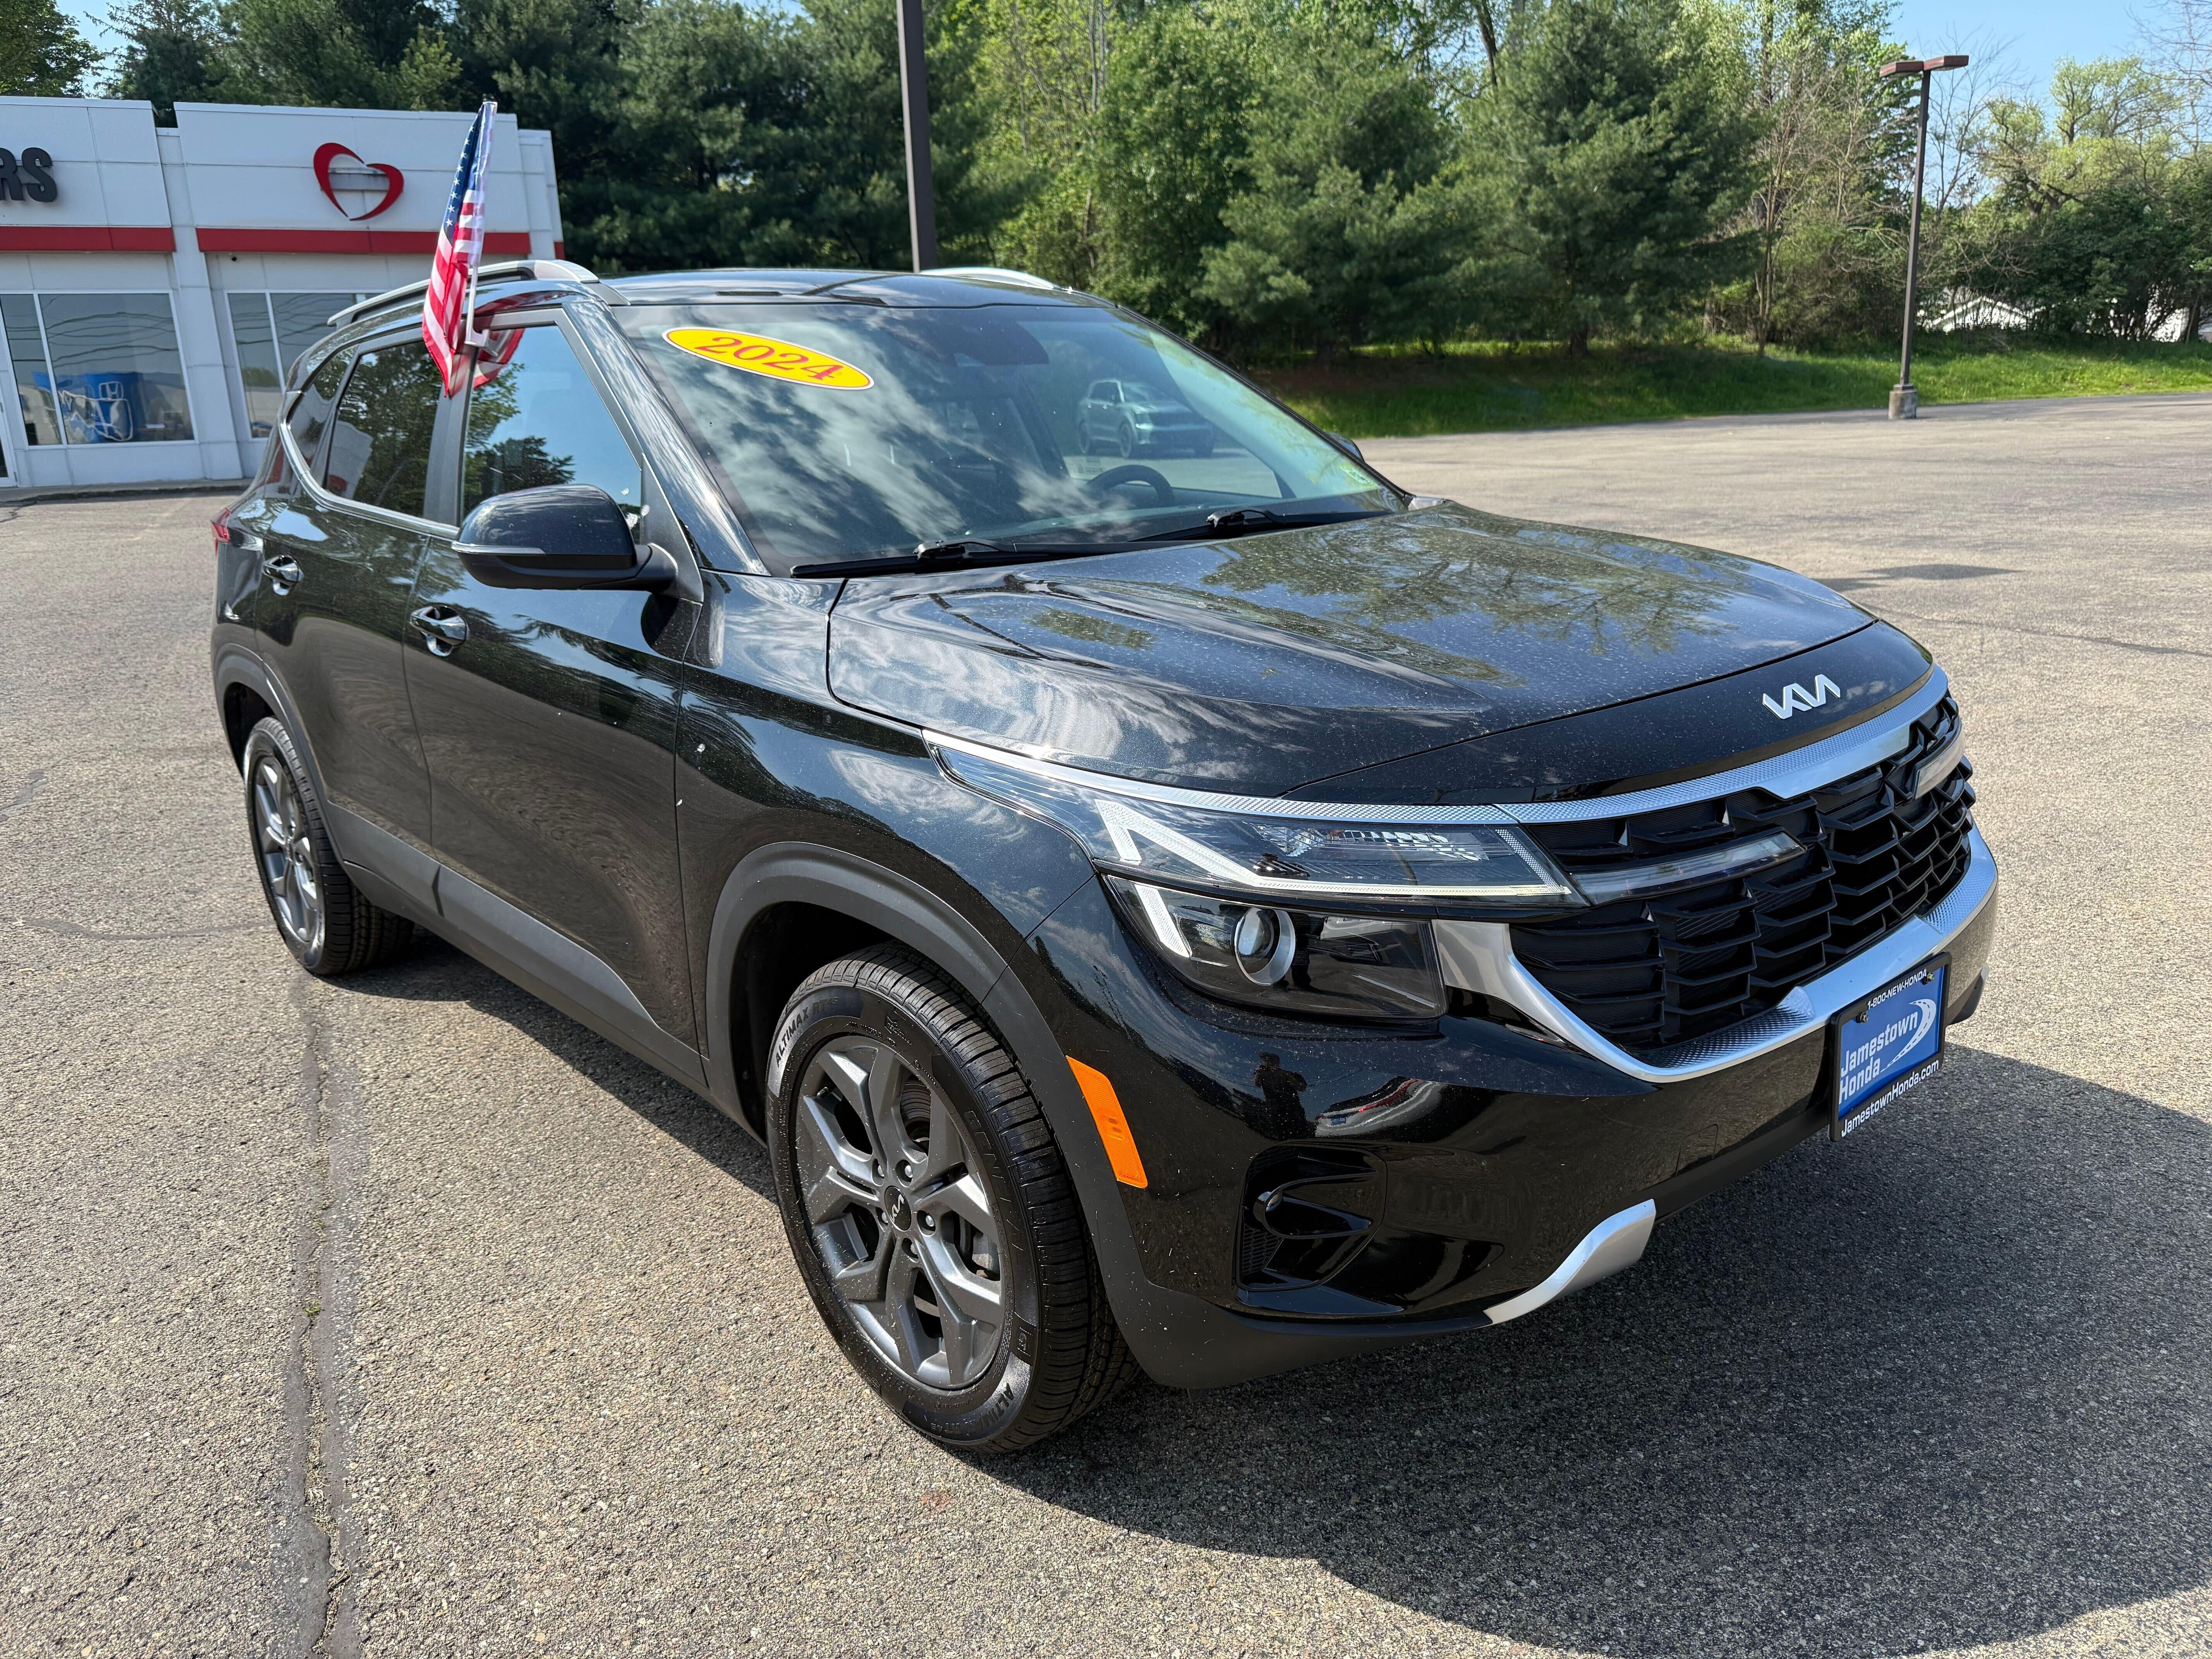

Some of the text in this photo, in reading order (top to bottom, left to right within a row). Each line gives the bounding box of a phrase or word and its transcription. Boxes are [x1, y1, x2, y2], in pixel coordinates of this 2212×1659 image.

[694, 337, 844, 380] 2024
[1762, 674, 1841, 720] KIA
[1867, 969, 1927, 1010] 1-800-NEW-HONDA
[776, 1007, 809, 1068] ALTIMAX
[1841, 1011, 1918, 1077] Jamestown
[1839, 1057, 1881, 1104] Honda
[1841, 1060, 1939, 1137] JamestownHonda.com
